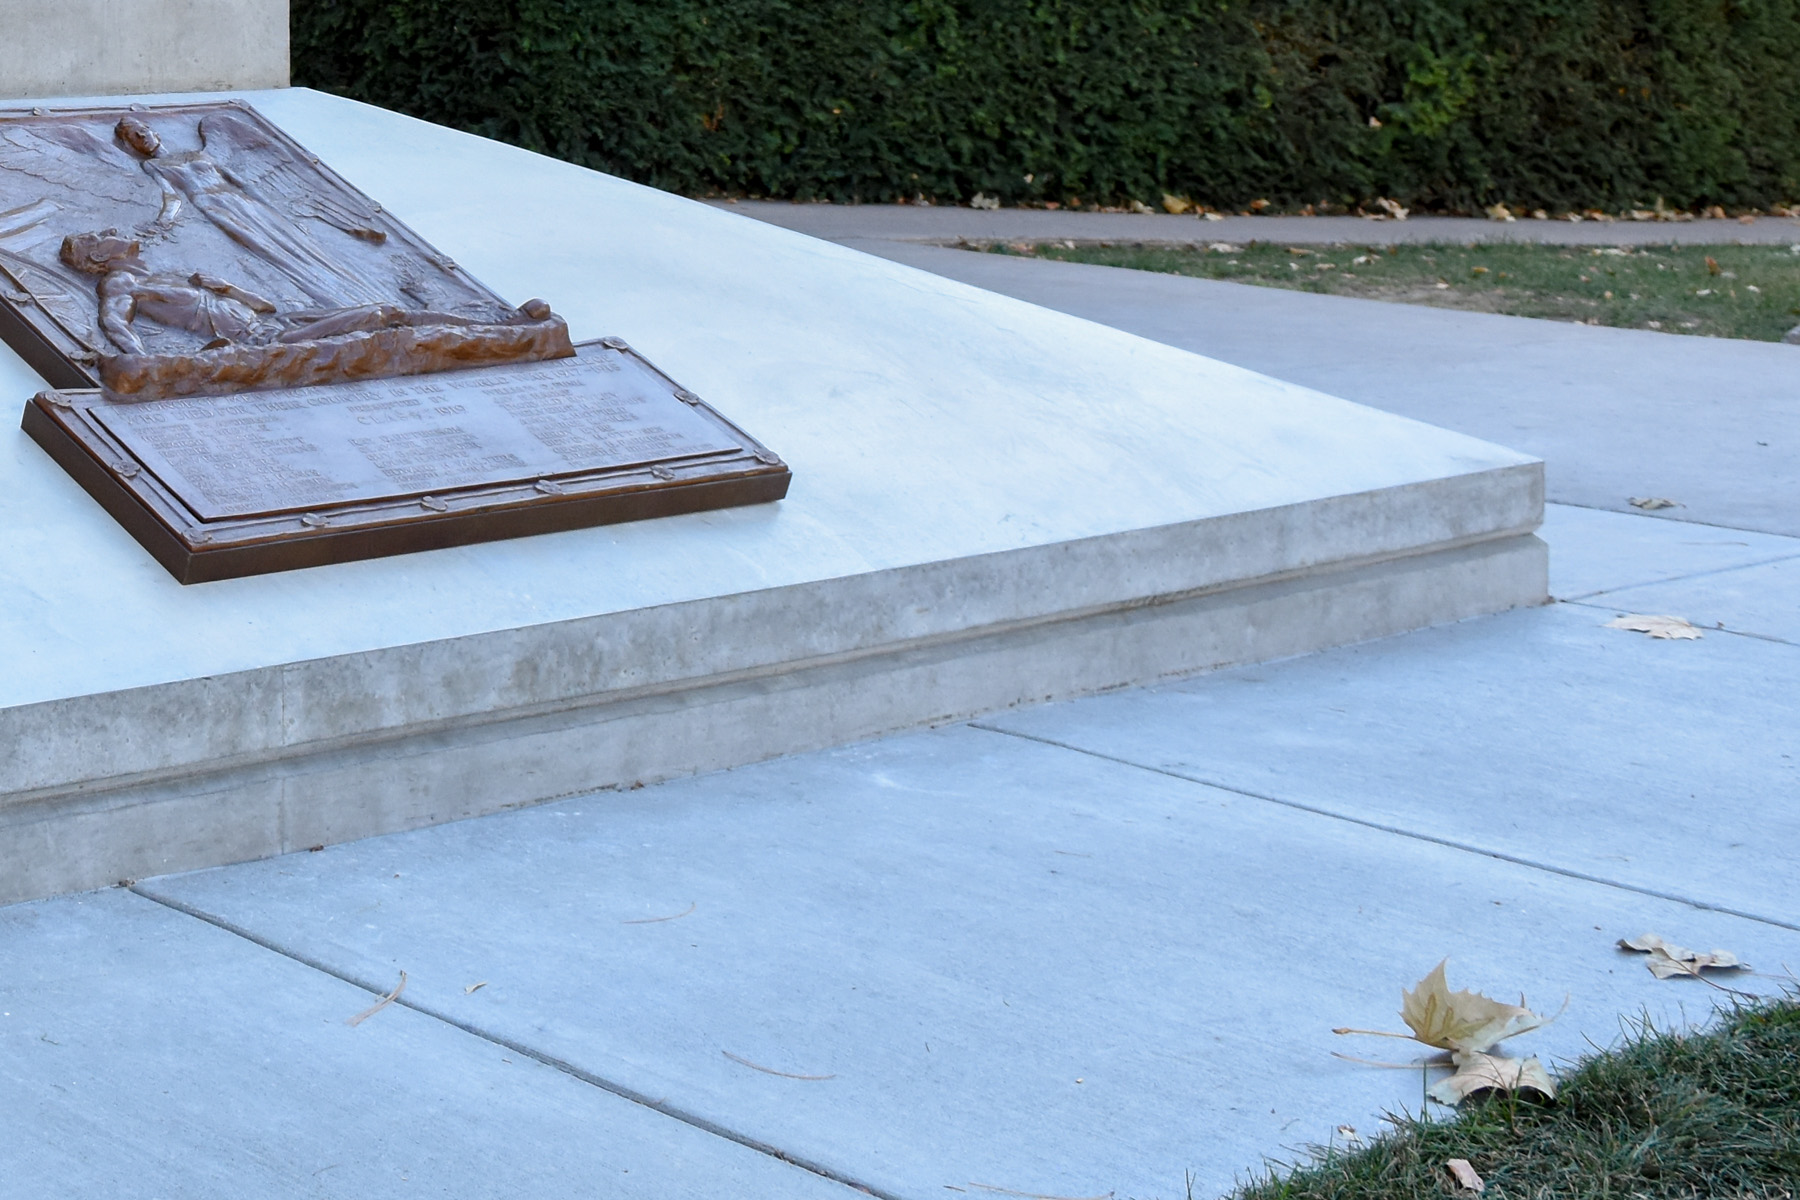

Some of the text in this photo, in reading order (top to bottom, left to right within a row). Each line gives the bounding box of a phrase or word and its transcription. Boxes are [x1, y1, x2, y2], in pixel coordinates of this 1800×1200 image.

[122, 413, 166, 424] WHO
[171, 408, 214, 420] DIED
[213, 405, 254, 416] FOR
[252, 399, 307, 412] THEIR
[305, 391, 386, 406] COUNTRY
[410, 384, 445, 393] THE
[446, 376, 510, 389] WORLD
[510, 371, 552, 382] WAR
